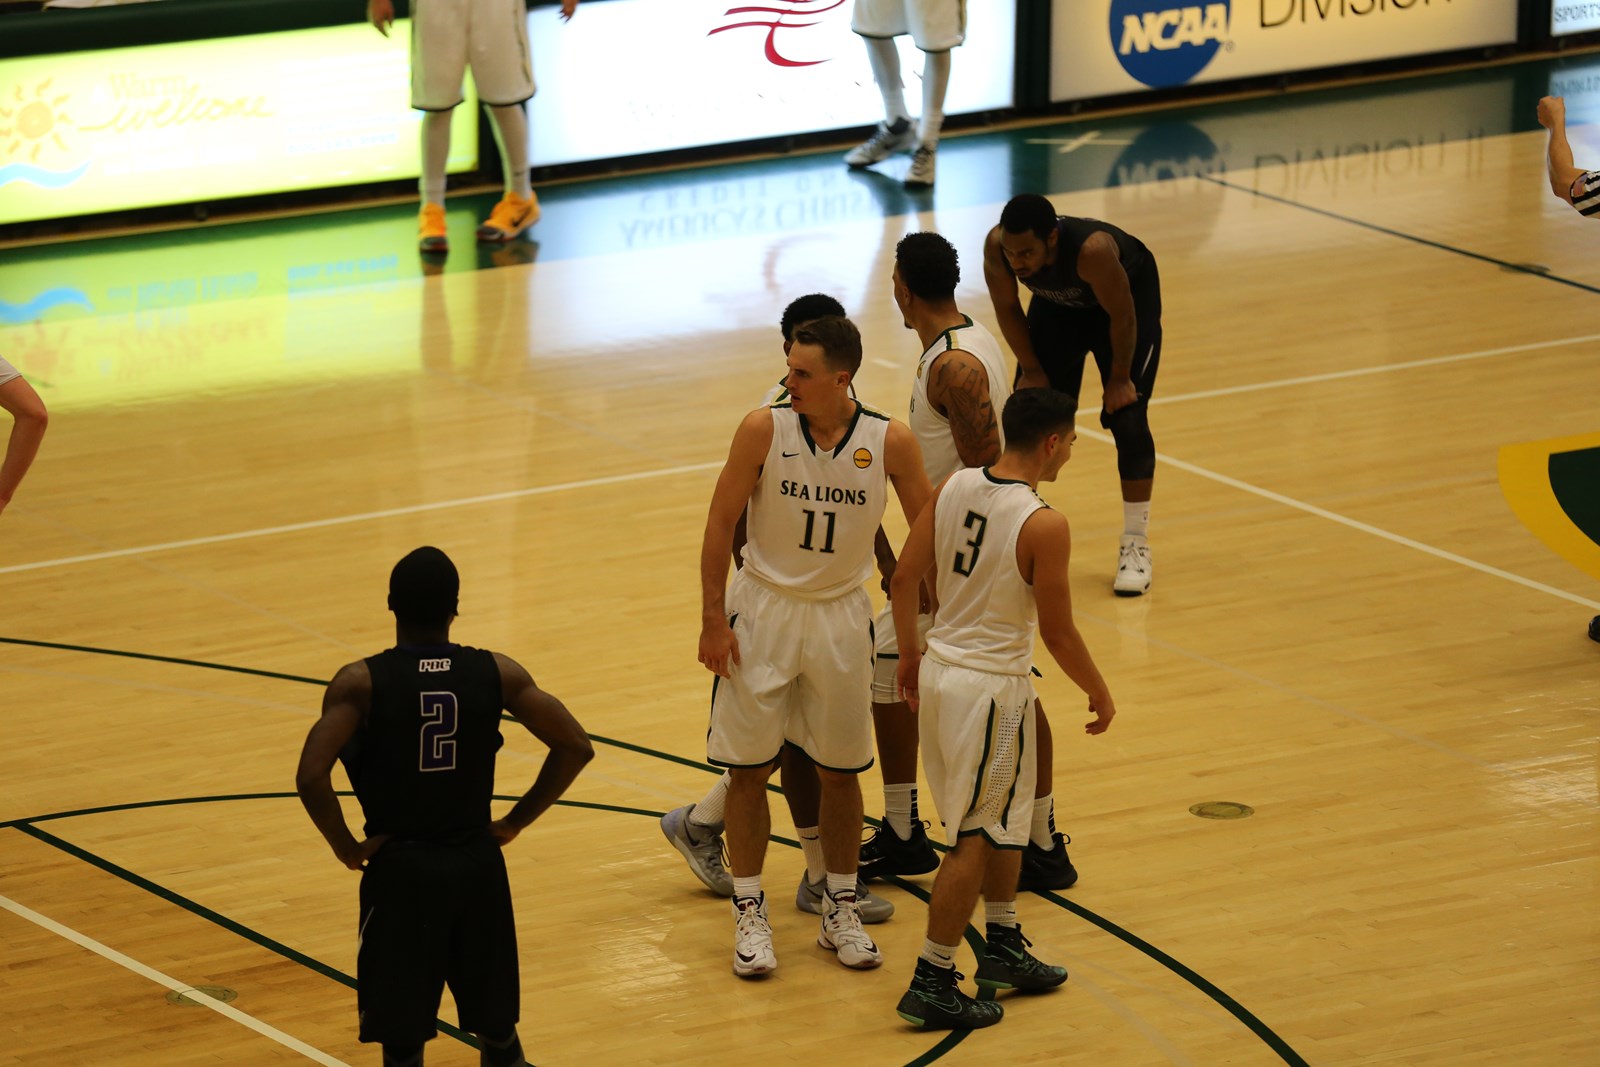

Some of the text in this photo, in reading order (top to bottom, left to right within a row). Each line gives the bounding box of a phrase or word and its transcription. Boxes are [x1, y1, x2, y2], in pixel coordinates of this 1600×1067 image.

[1119, 3, 1228, 55] NCAA
[780, 480, 866, 505] SEA LIONS
[799, 509, 836, 554] 11
[953, 509, 988, 578] 3
[419, 691, 458, 772] 2
